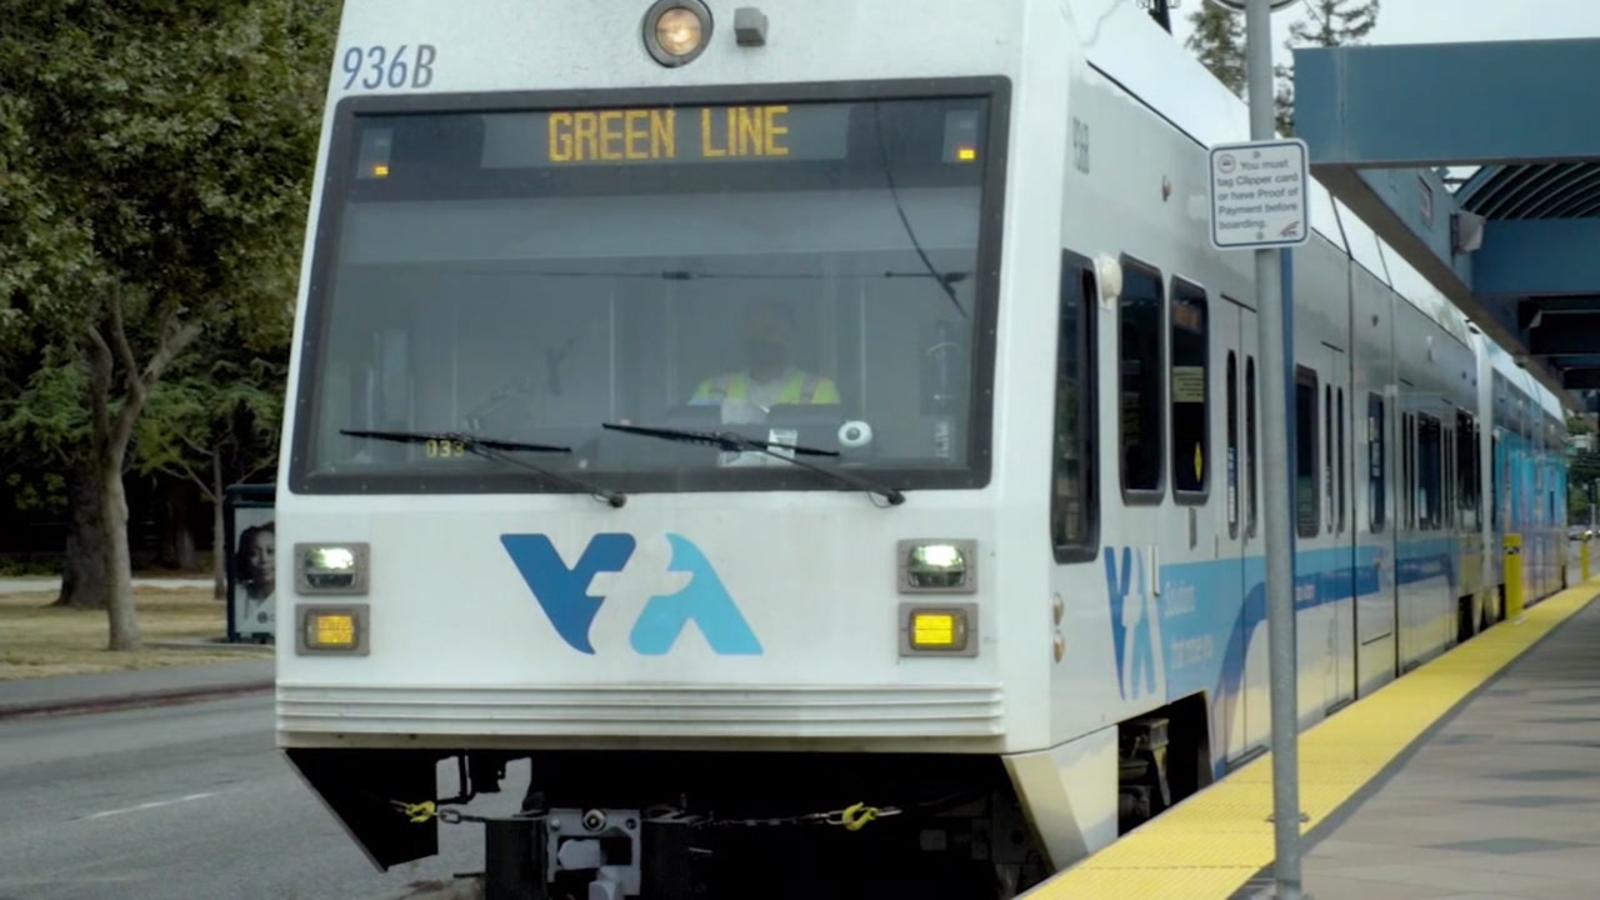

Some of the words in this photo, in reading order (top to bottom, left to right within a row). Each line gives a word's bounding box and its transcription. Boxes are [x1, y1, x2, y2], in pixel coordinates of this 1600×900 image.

[342, 44, 437, 90] 936B
[548, 109, 676, 163] GREEN
[701, 105, 790, 158] LINE
[1240, 162, 1259, 171] You
[1261, 159, 1289, 169] must
[1217, 178, 1234, 187] tag
[1236, 176, 1273, 186] Clipper
[1275, 173, 1299, 183] card
[1230, 191, 1255, 200] have
[1257, 188, 1286, 198] Proof
[1287, 187, 1299, 196] of
[1218, 205, 1263, 216] Payment
[1264, 202, 1298, 213] before
